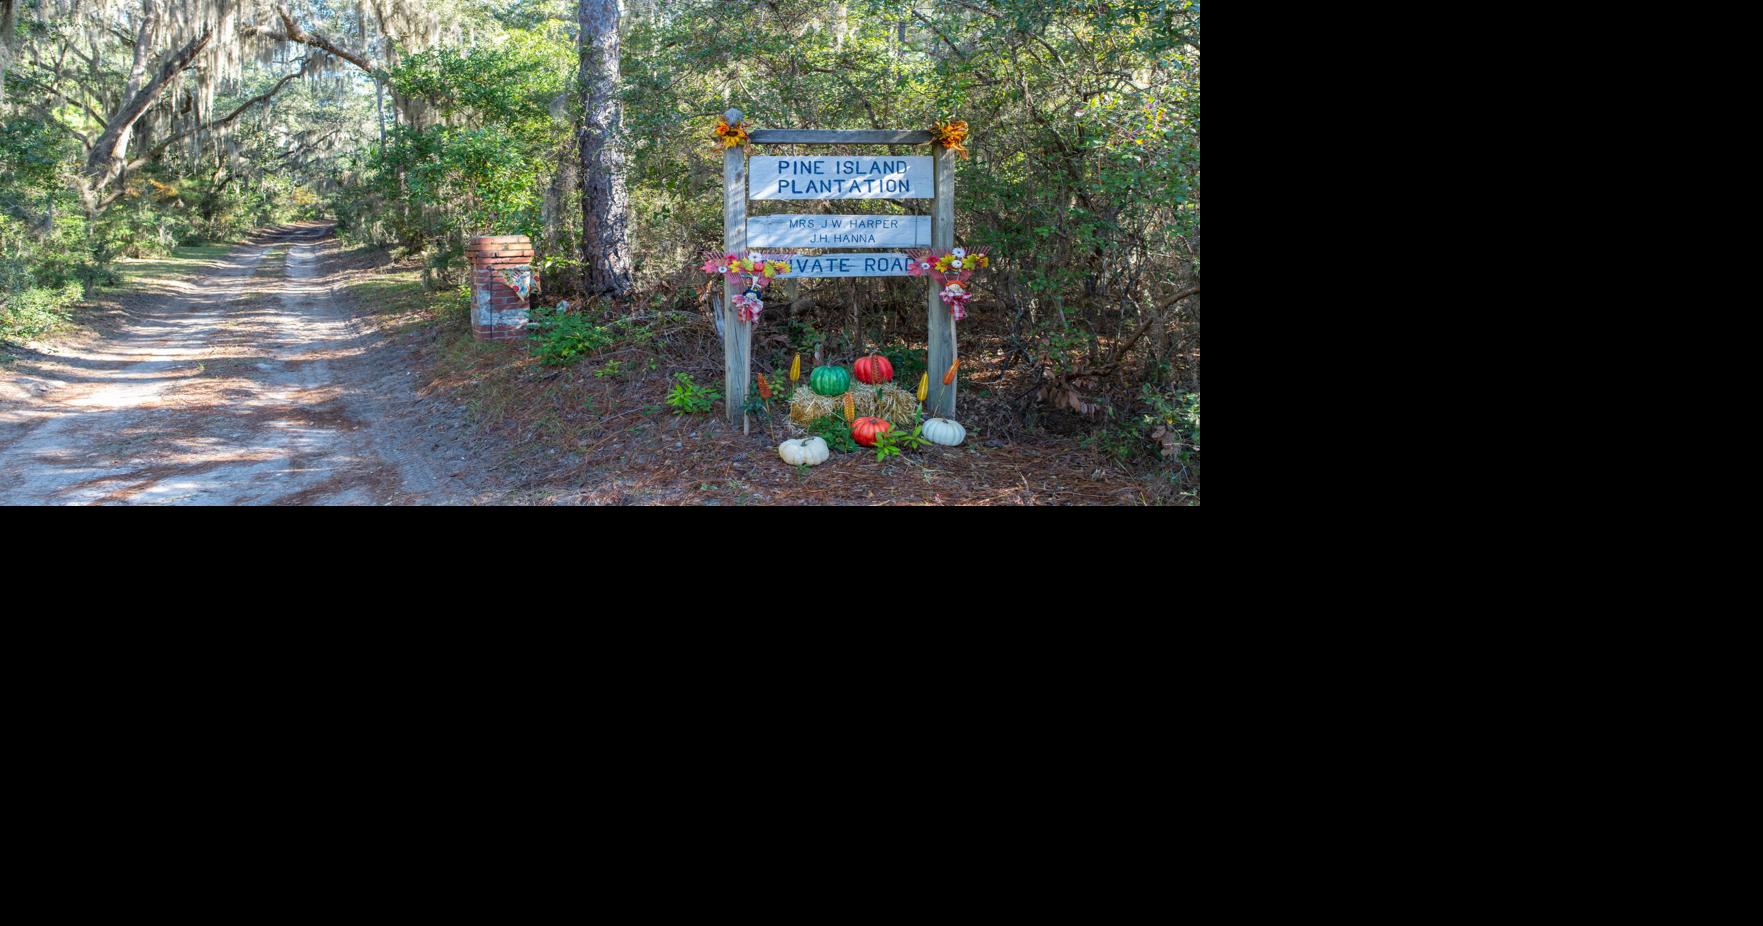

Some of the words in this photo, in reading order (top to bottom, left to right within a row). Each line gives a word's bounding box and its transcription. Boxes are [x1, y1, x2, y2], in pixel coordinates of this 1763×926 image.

[778, 160, 825, 175] PINE
[836, 160, 908, 175] ISLAND
[777, 179, 910, 194] PLANTATION
[789, 219, 815, 229] MRS
[849, 219, 899, 229] HARPER
[833, 234, 876, 244] HANNA
[762, 258, 851, 273] IVATE
